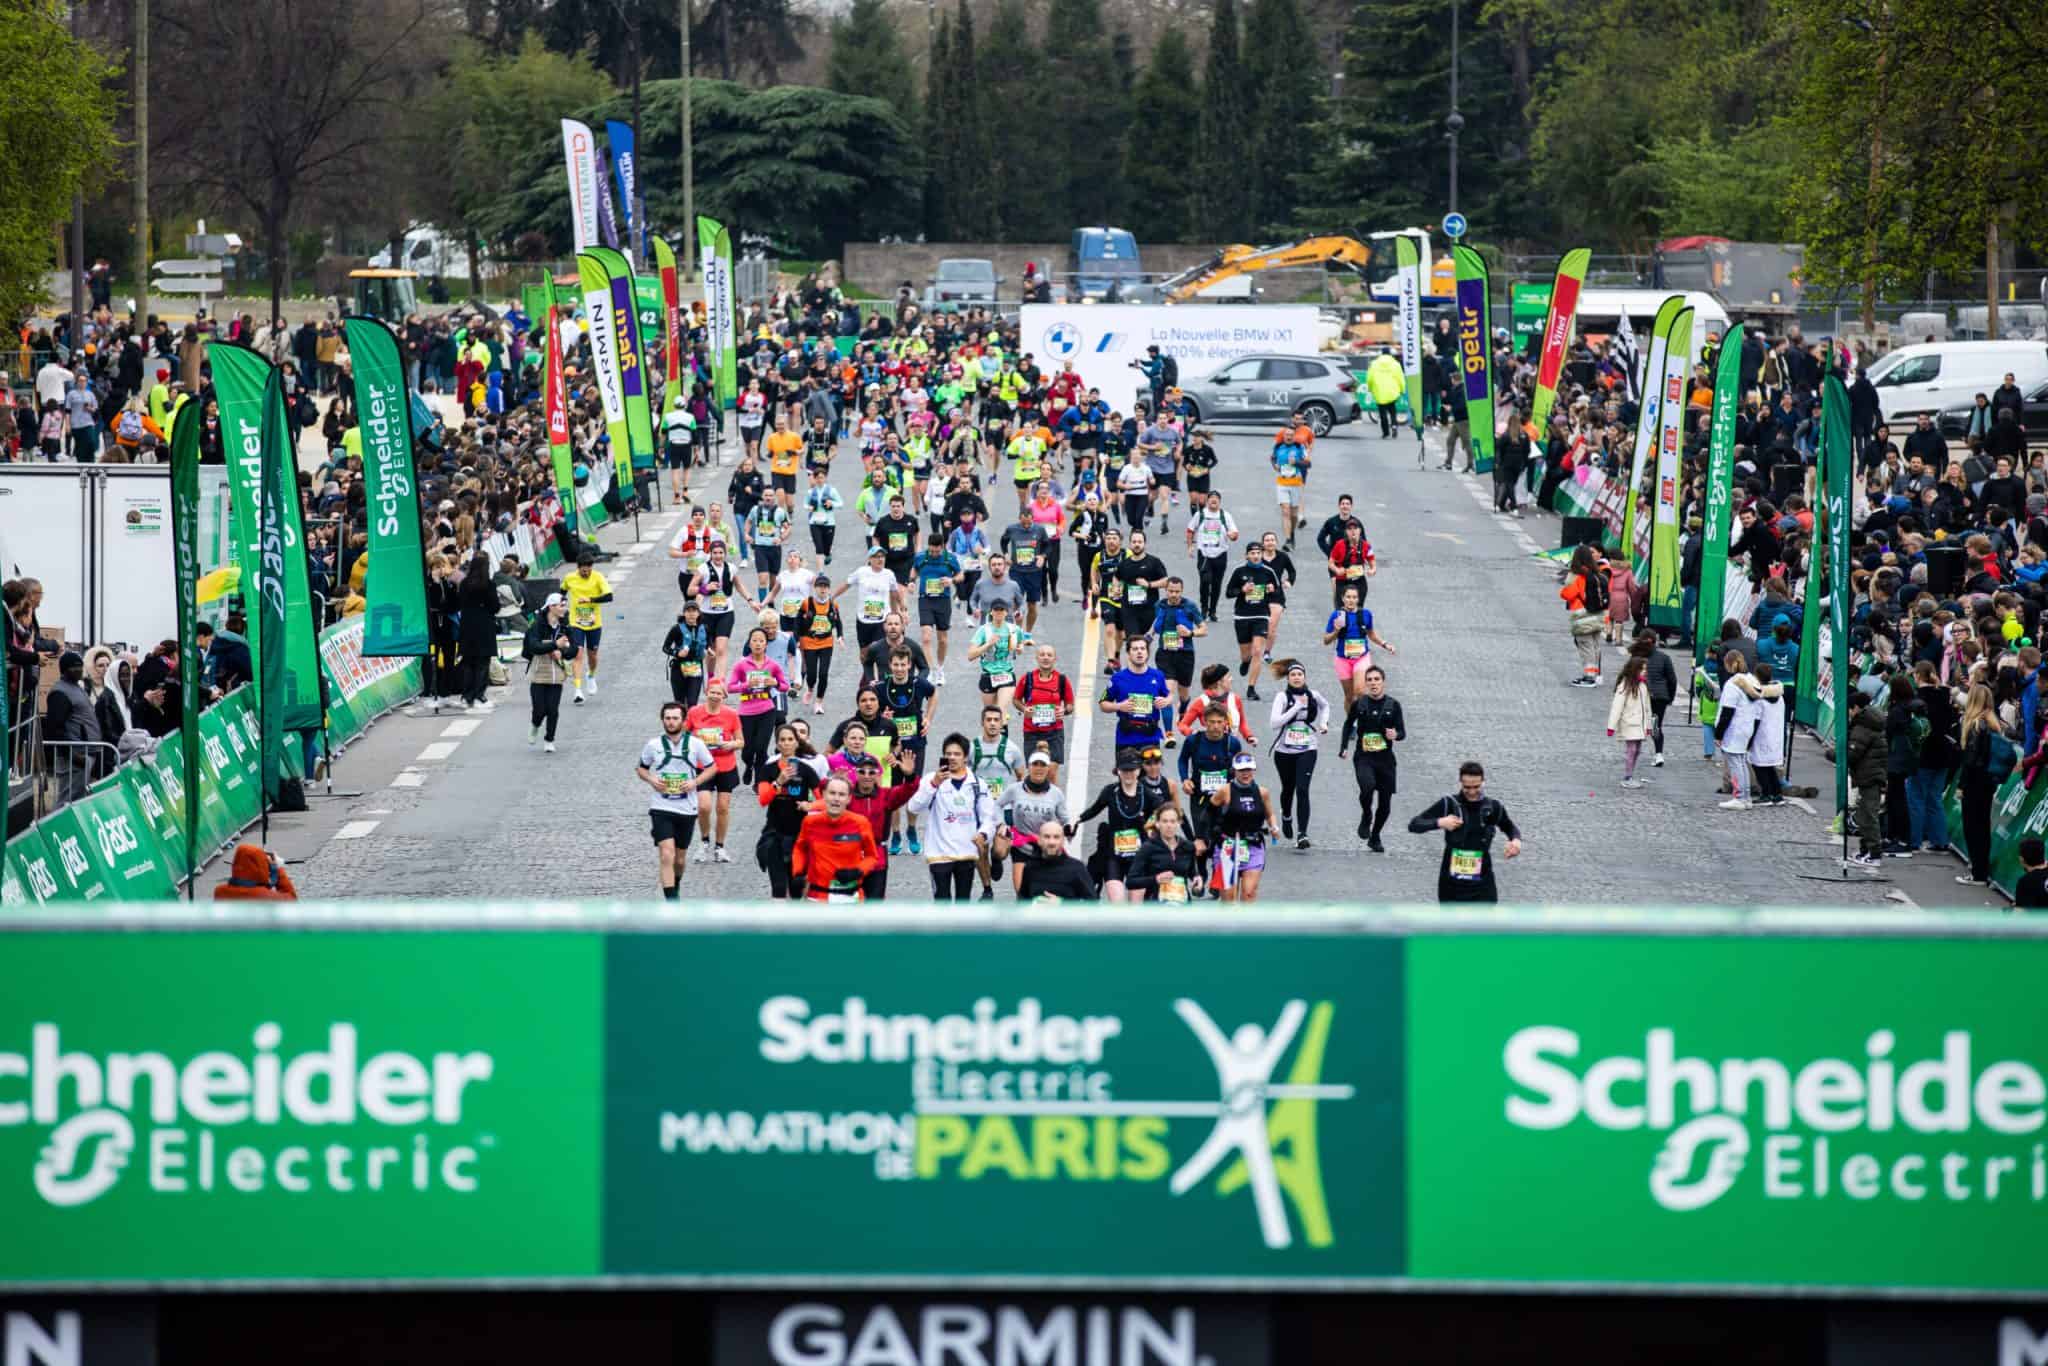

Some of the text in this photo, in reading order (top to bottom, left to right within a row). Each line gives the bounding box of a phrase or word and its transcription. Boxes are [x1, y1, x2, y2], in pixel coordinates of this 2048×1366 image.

[640, 311, 657, 325] 42
[1151, 327, 1293, 342] La Nouvelle BMW iX1
[1459, 306, 1486, 374] getir
[1534, 318, 1547, 331] 4
[1551, 315, 1567, 346] Vittel
[592, 303, 619, 413] GARMIN
[1164, 345, 1204, 359] 100%
[388, 383, 406, 469] Electric
[1270, 391, 1289, 405] iX1
[367, 383, 399, 537] Schneider
[758, 996, 1121, 1063] Schneider
[912, 1060, 1112, 1103] Electric
[1502, 1025, 2047, 1135] Schneide
[149, 1129, 479, 1193] Electric
[660, 1112, 915, 1154] MARATHON
[914, 1114, 1171, 1182] PARIS
[875, 1155, 915, 1181] DE
[1763, 1134, 2046, 1202] Electri
[768, 1304, 1196, 1366] GARMIN
